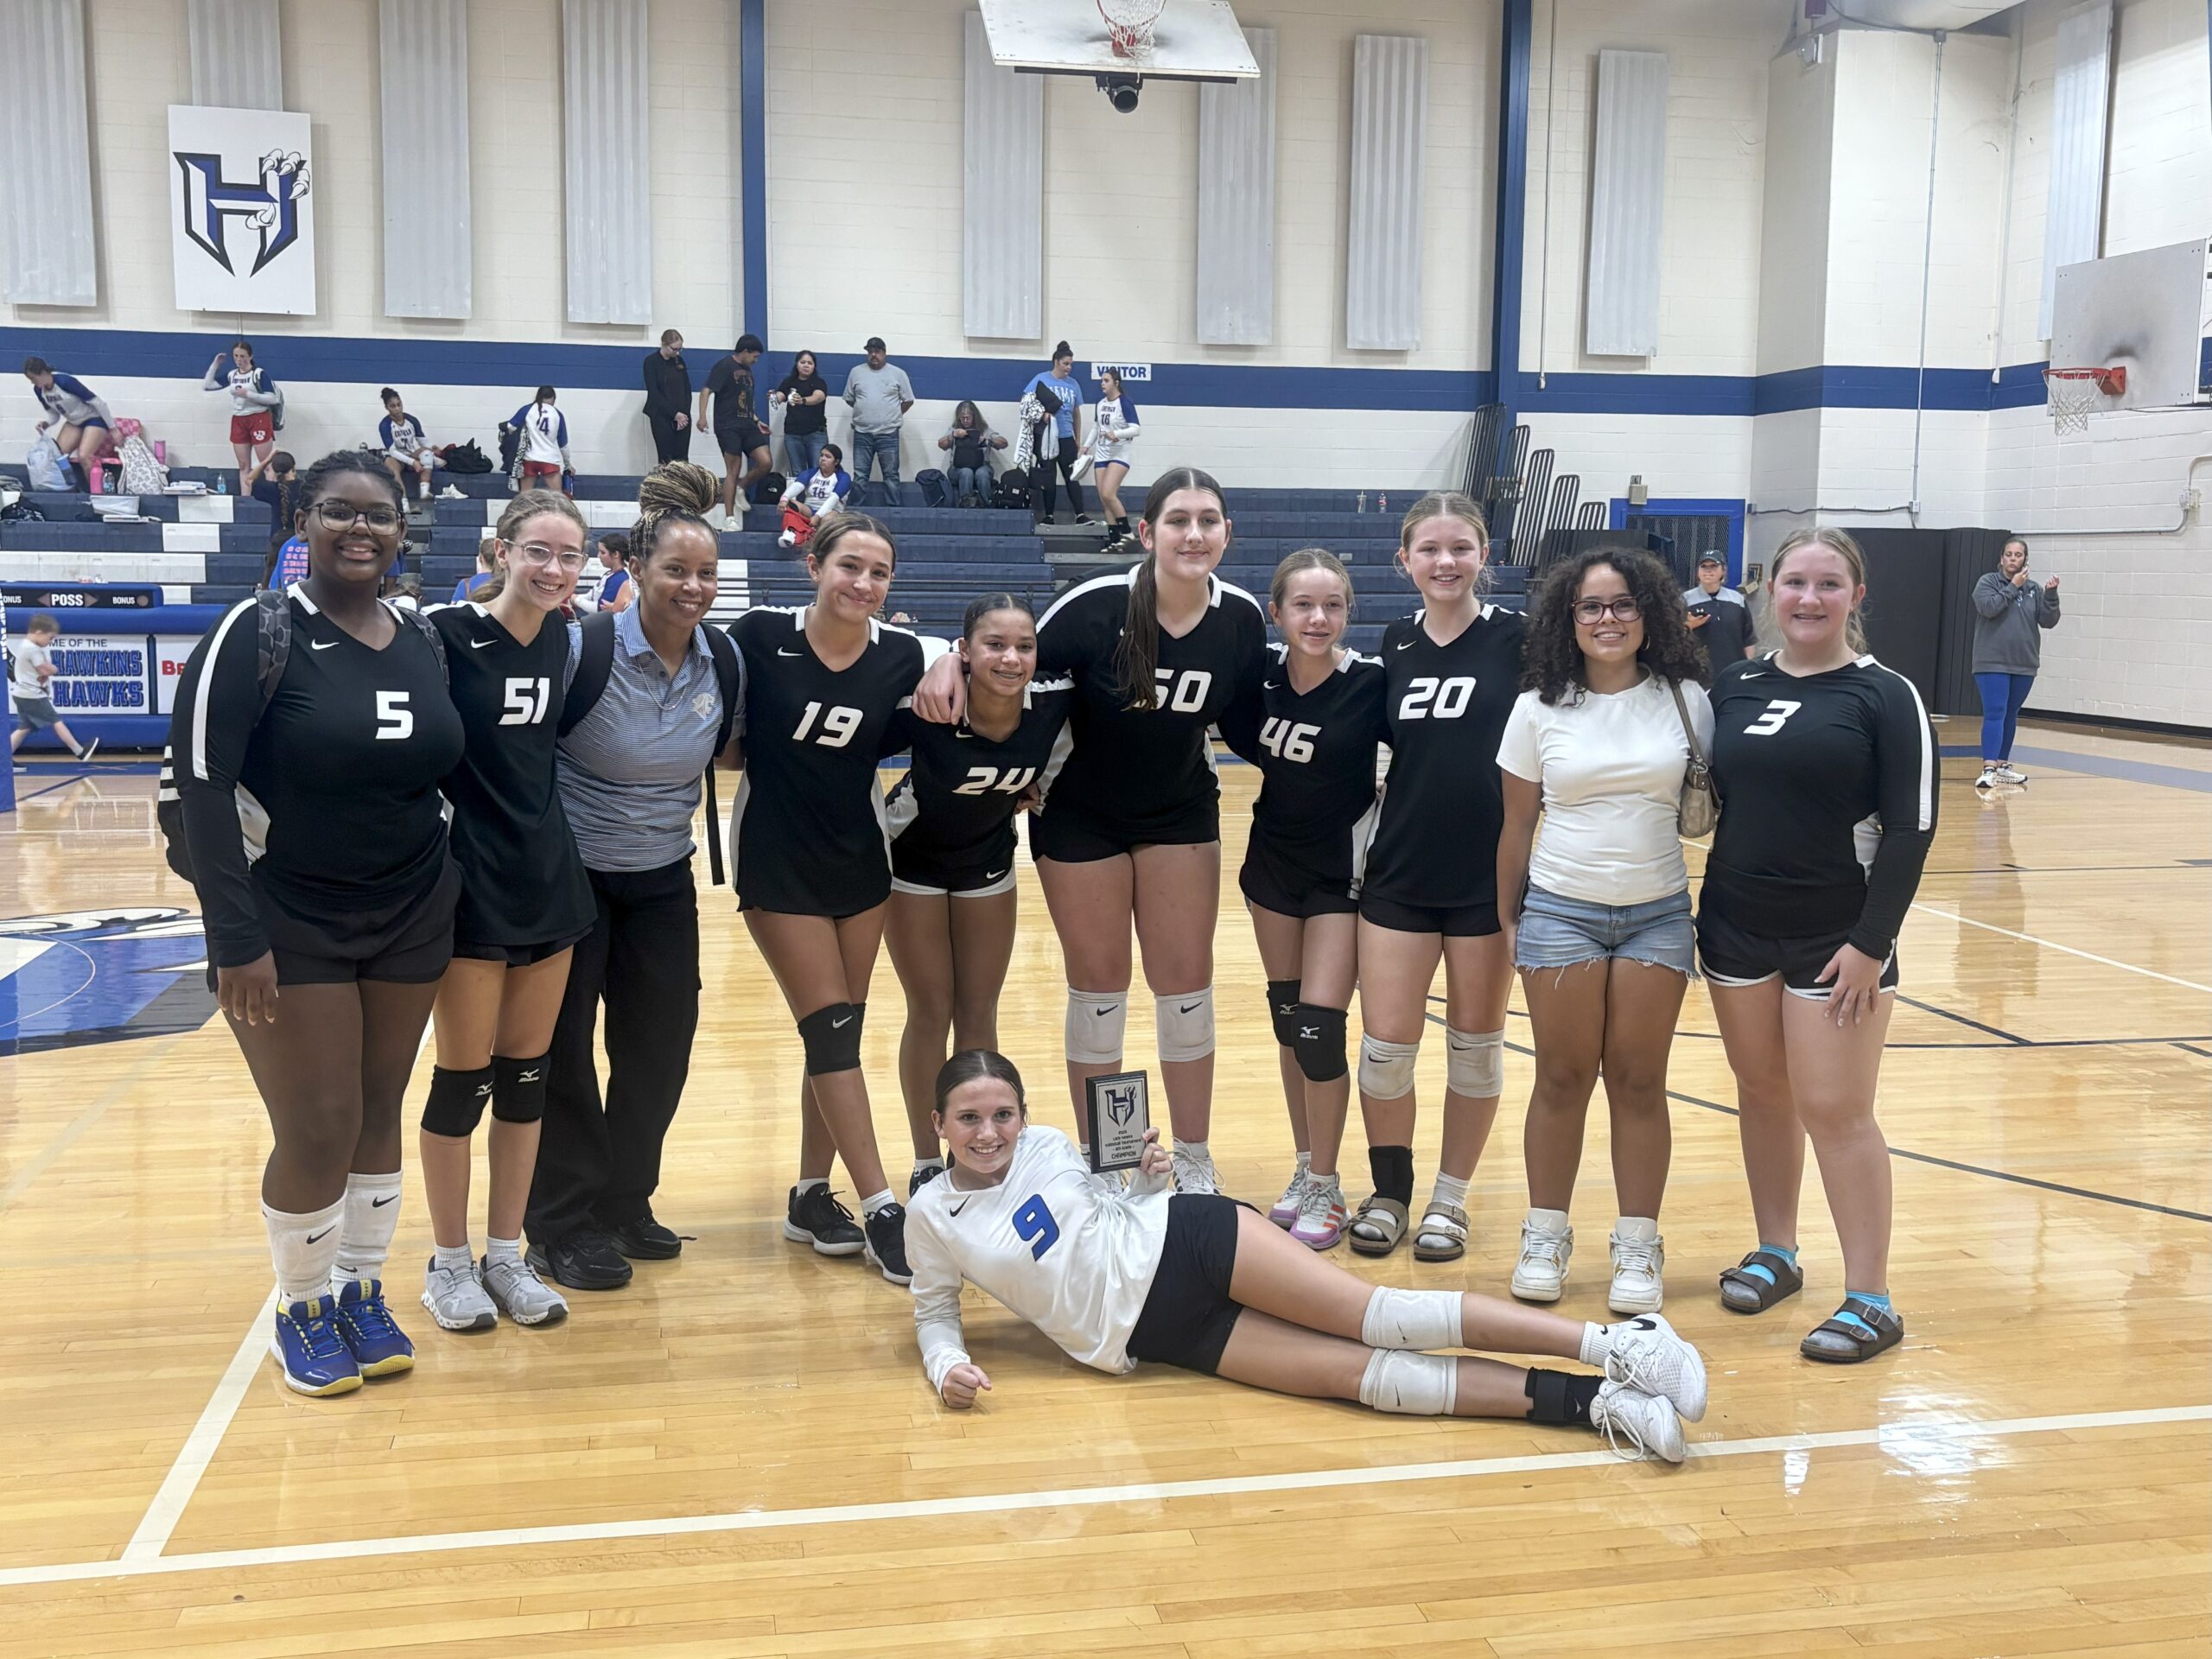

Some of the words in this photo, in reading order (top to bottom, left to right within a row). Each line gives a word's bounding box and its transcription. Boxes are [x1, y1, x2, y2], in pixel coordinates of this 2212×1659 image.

[173, 150, 309, 277] H
[539, 417, 550, 435] 4
[3, 595, 22, 604] ONUS
[51, 594, 84, 606] POSS
[112, 596, 136, 605] BONUS
[48, 639, 67, 647] ME
[68, 639, 83, 647] OF
[87, 639, 107, 647] THE
[50, 650, 143, 677] HAWKINS
[52, 681, 144, 707] HAWKS
[498, 677, 550, 725] 51
[1398, 677, 1477, 720] 20
[375, 690, 414, 739] 5
[791, 701, 863, 748] 19
[1743, 699, 1802, 735] 3
[1259, 716, 1322, 764] 46
[951, 766, 1036, 795] 24
[1012, 1193, 1059, 1262] 9
